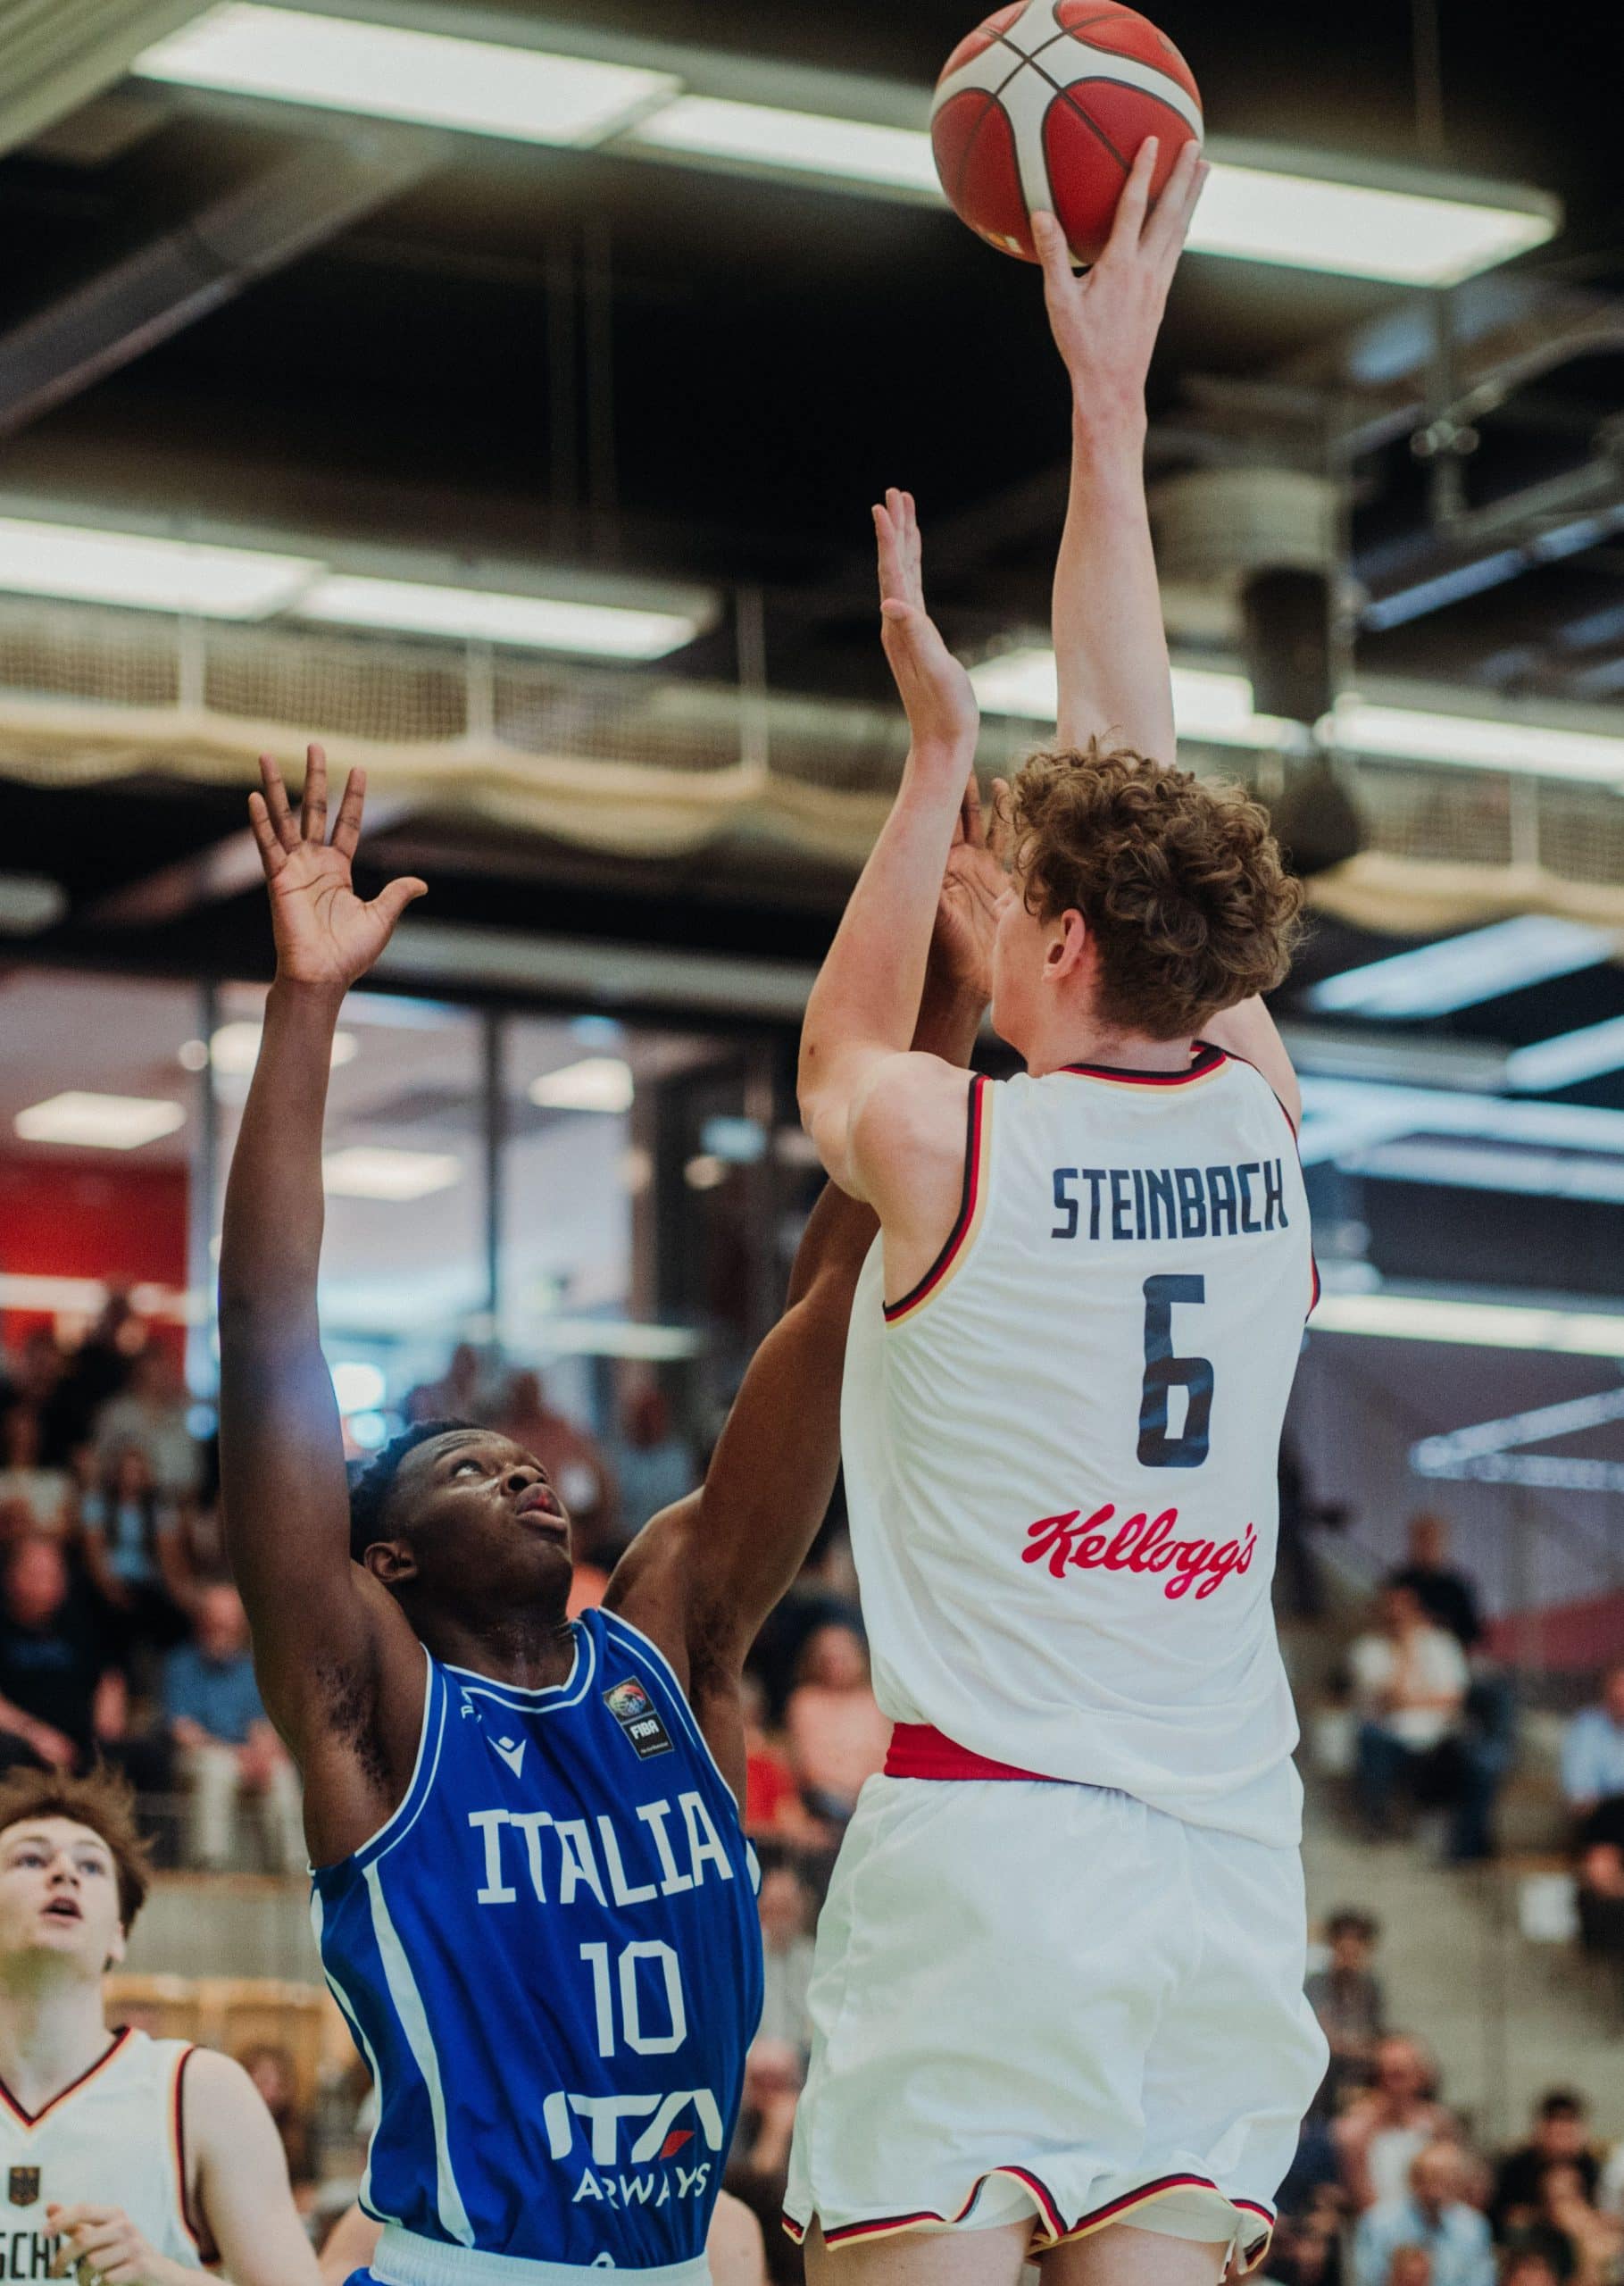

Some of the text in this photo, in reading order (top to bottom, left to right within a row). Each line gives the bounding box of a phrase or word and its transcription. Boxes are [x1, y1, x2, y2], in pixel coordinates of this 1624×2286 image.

[1051, 1158, 1289, 1239] STEINBACH
[1137, 1274, 1214, 1468] 6
[1021, 1503, 1258, 1600] Kellogg's
[629, 1719, 660, 1740] FIBA
[468, 1790, 734, 1907] ITALIA
[580, 1940, 687, 2057] 10
[543, 2088, 724, 2166] ITA
[571, 2162, 712, 2210] ARWAYS
